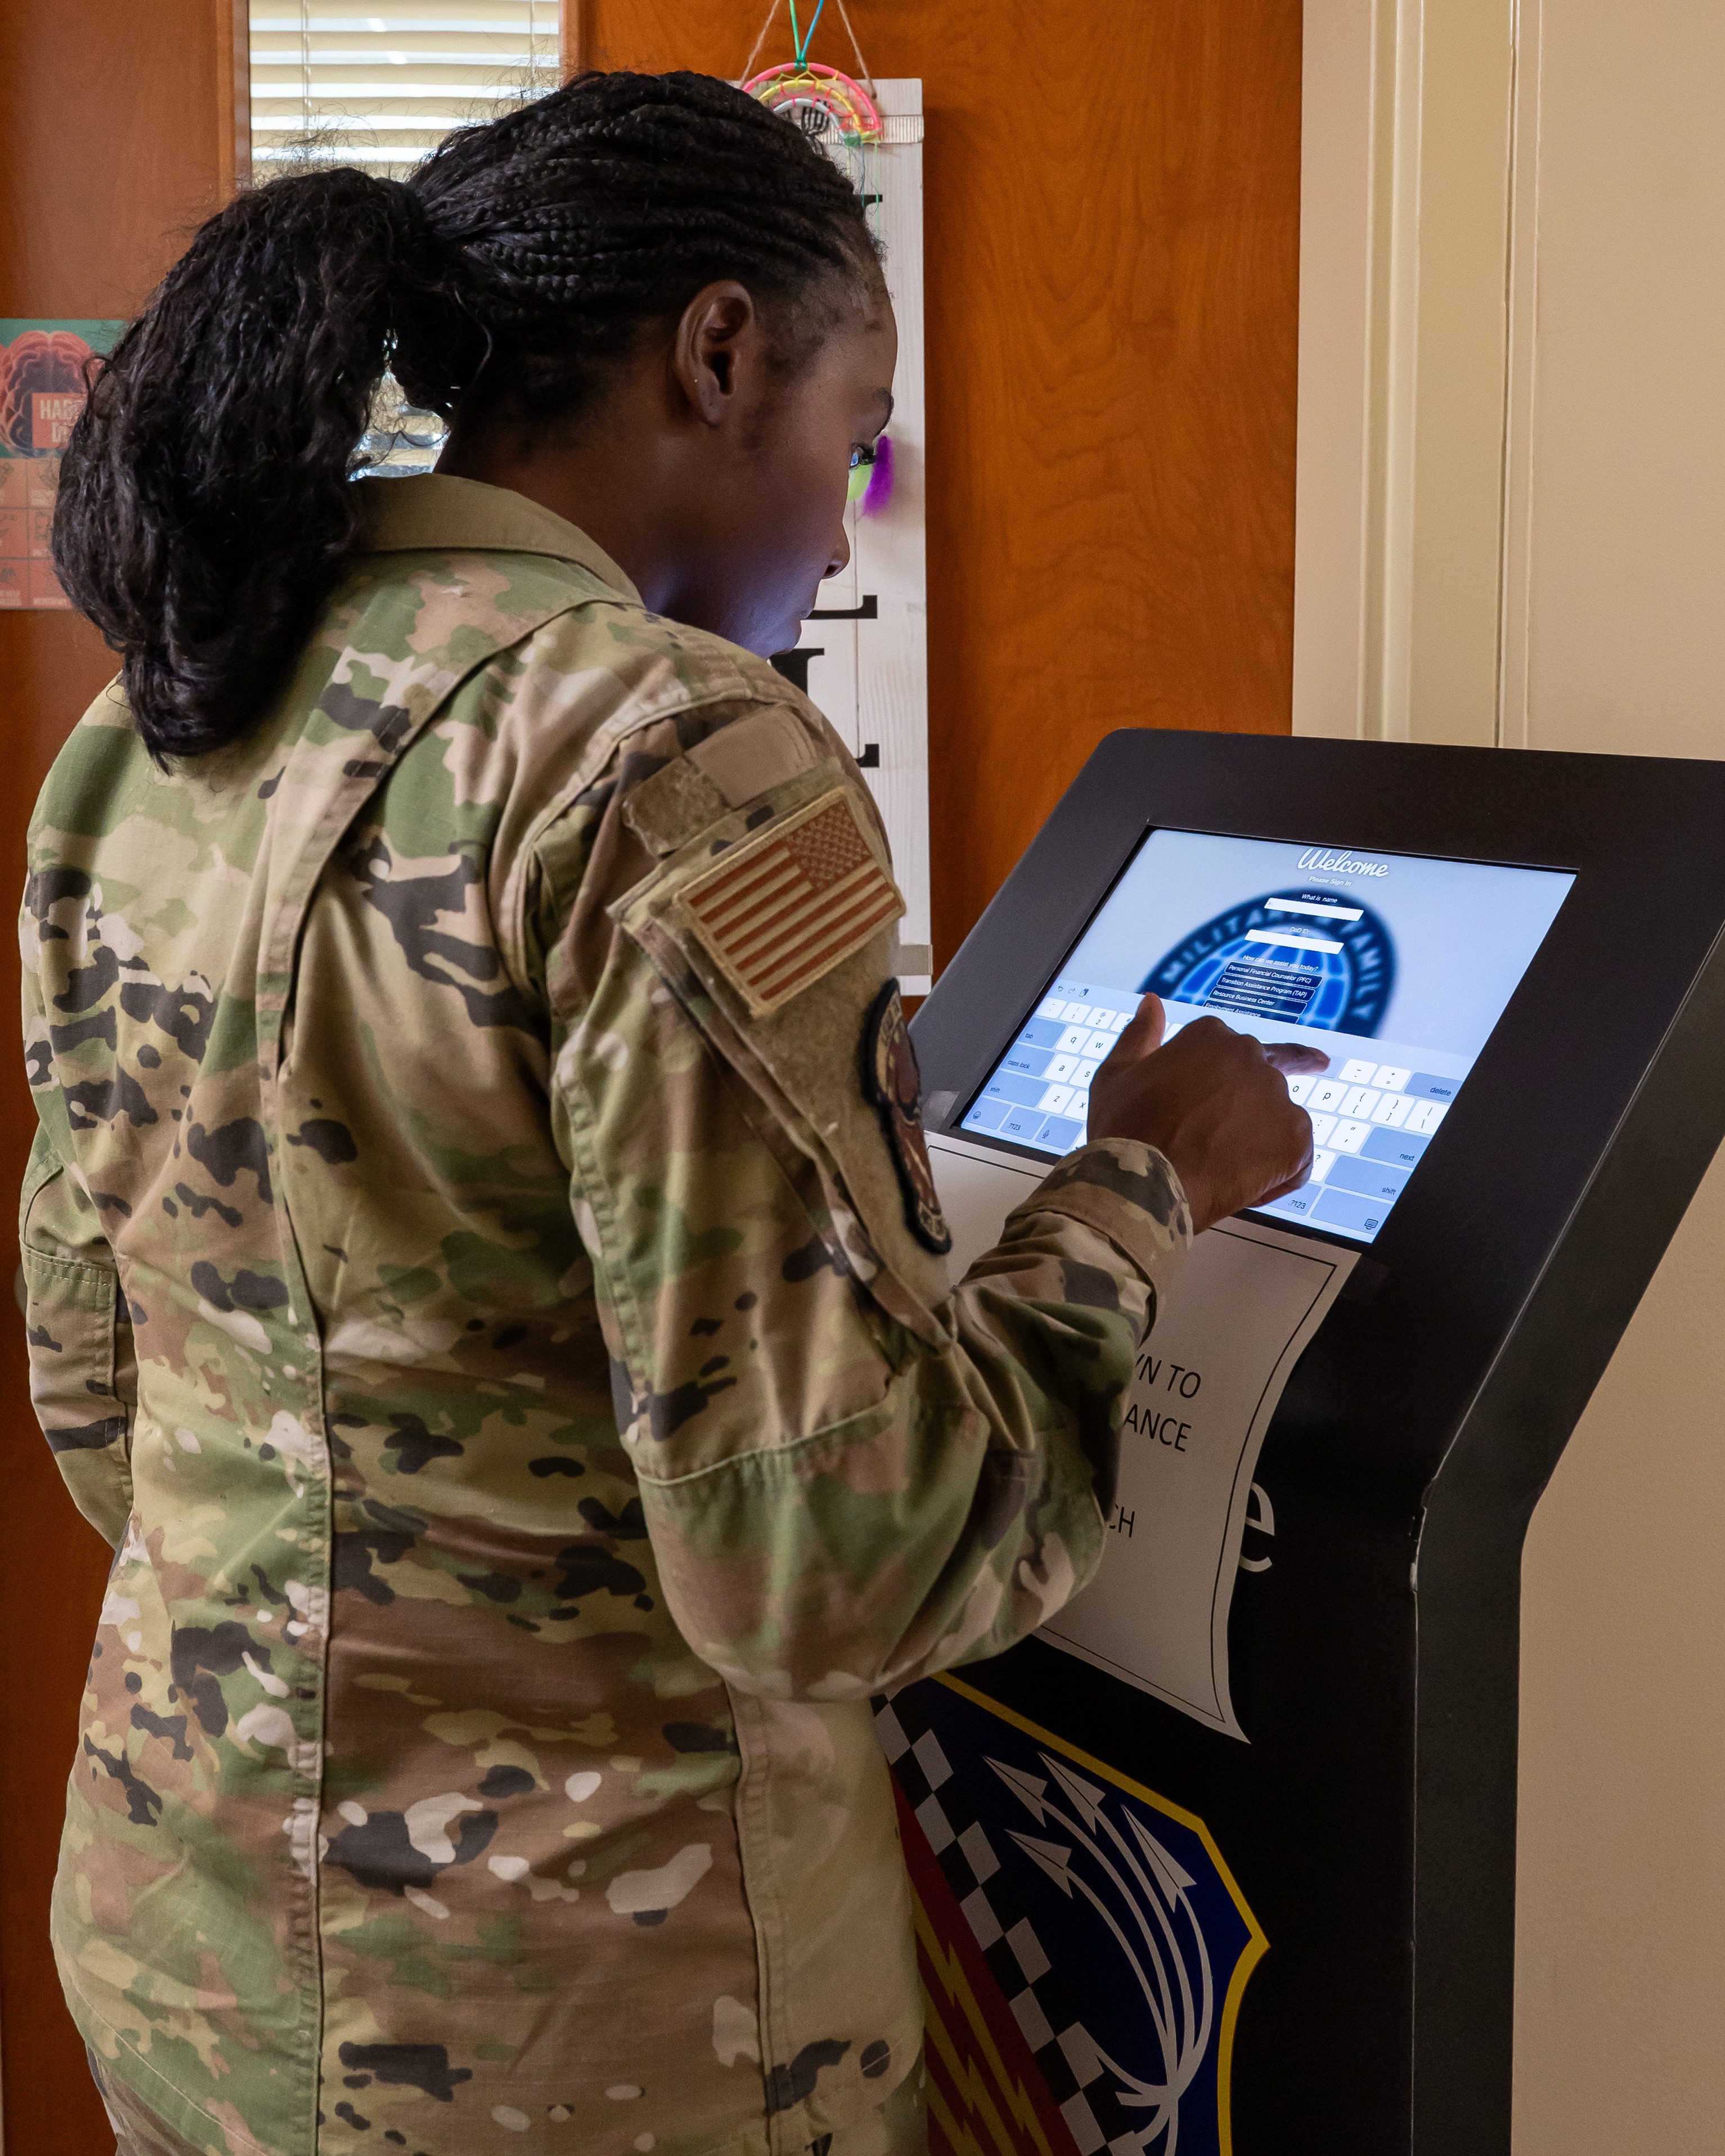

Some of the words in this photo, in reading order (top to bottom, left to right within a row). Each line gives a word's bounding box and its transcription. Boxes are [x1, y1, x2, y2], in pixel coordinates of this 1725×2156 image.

[1297, 848, 1389, 877] Welcome
[1228, 965, 1250, 973] Personal
[1249, 968, 1272, 976] Financial
[1271, 973, 1297, 981] Counselor
[1299, 964, 1319, 973] today?
[1221, 977, 1245, 986] Transition
[1245, 982, 1270, 991] Assistance
[1270, 986, 1292, 995] Program
[1212, 990, 1235, 999] Resource
[1236, 994, 1256, 1003] Business
[1322, 1092, 1331, 1101] p
[1430, 1087, 1452, 1097] delete
[1399, 1153, 1416, 1162] next
[1287, 1199, 1307, 1210] .?123
[1166, 1363, 1202, 1399] TO
